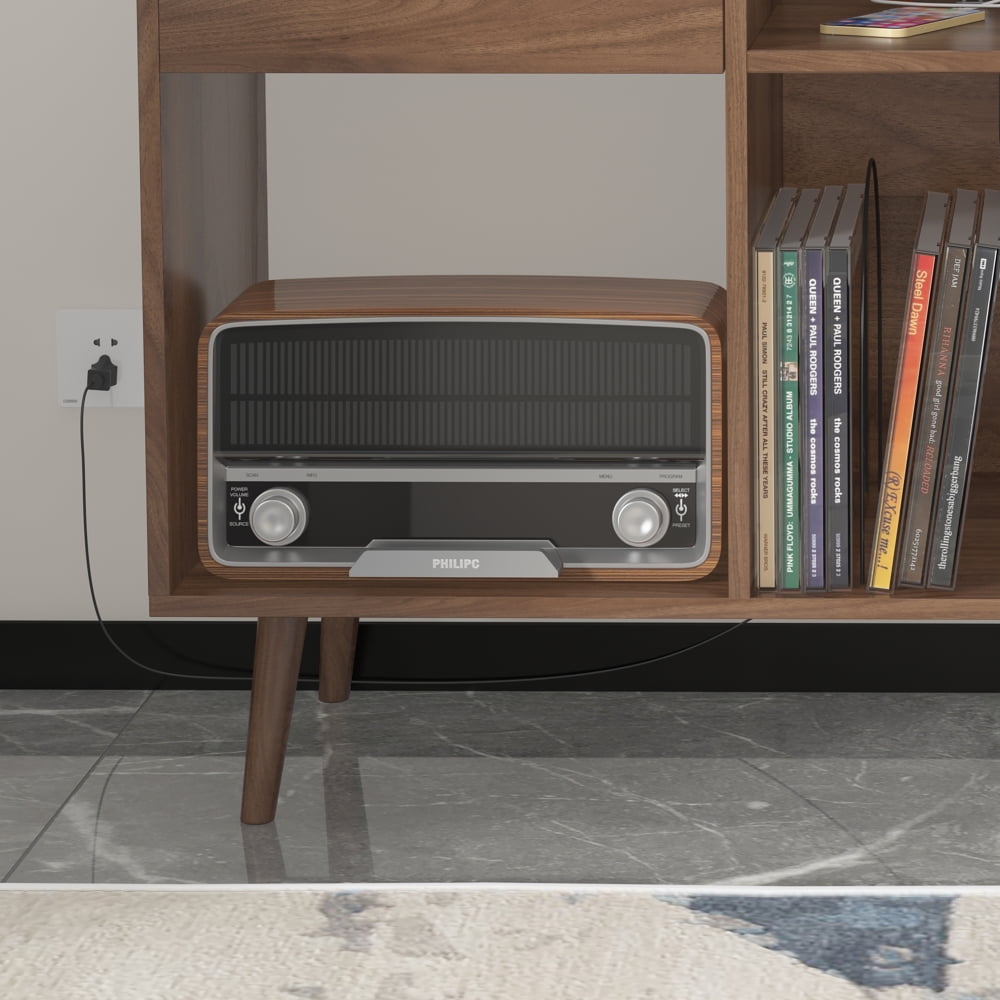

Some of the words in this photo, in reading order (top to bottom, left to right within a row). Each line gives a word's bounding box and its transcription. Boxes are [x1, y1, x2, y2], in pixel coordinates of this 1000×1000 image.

[953, 258, 962, 273] DEF
[913, 270, 928, 299] Steel
[951, 273, 960, 288] JAM
[809, 278, 818, 314] QUEEN
[832, 277, 842, 313] QUEEN
[908, 302, 923, 336] Dawn
[809, 325, 818, 348] PAUL
[832, 324, 842, 347] PAUL
[937, 327, 952, 376] RIHANNA
[809, 350, 818, 396] RODGERS
[832, 349, 842, 395] RODGERS
[935, 380, 944, 397] good
[931, 397, 941, 411] girl
[809, 418, 818, 435] the
[833, 417, 842, 433] the
[929, 411, 938, 429] gone
[928, 429, 938, 444] bad:
[809, 437, 818, 475] cosmos
[833, 436, 842, 474] cosmos
[920, 445, 935, 495] RELOADED
[809, 477, 818, 505] rocks
[833, 477, 842, 504] rocks
[937, 456, 963, 570] therollingstonesabiggerbang
[432, 558, 480, 569] PHILIPC
